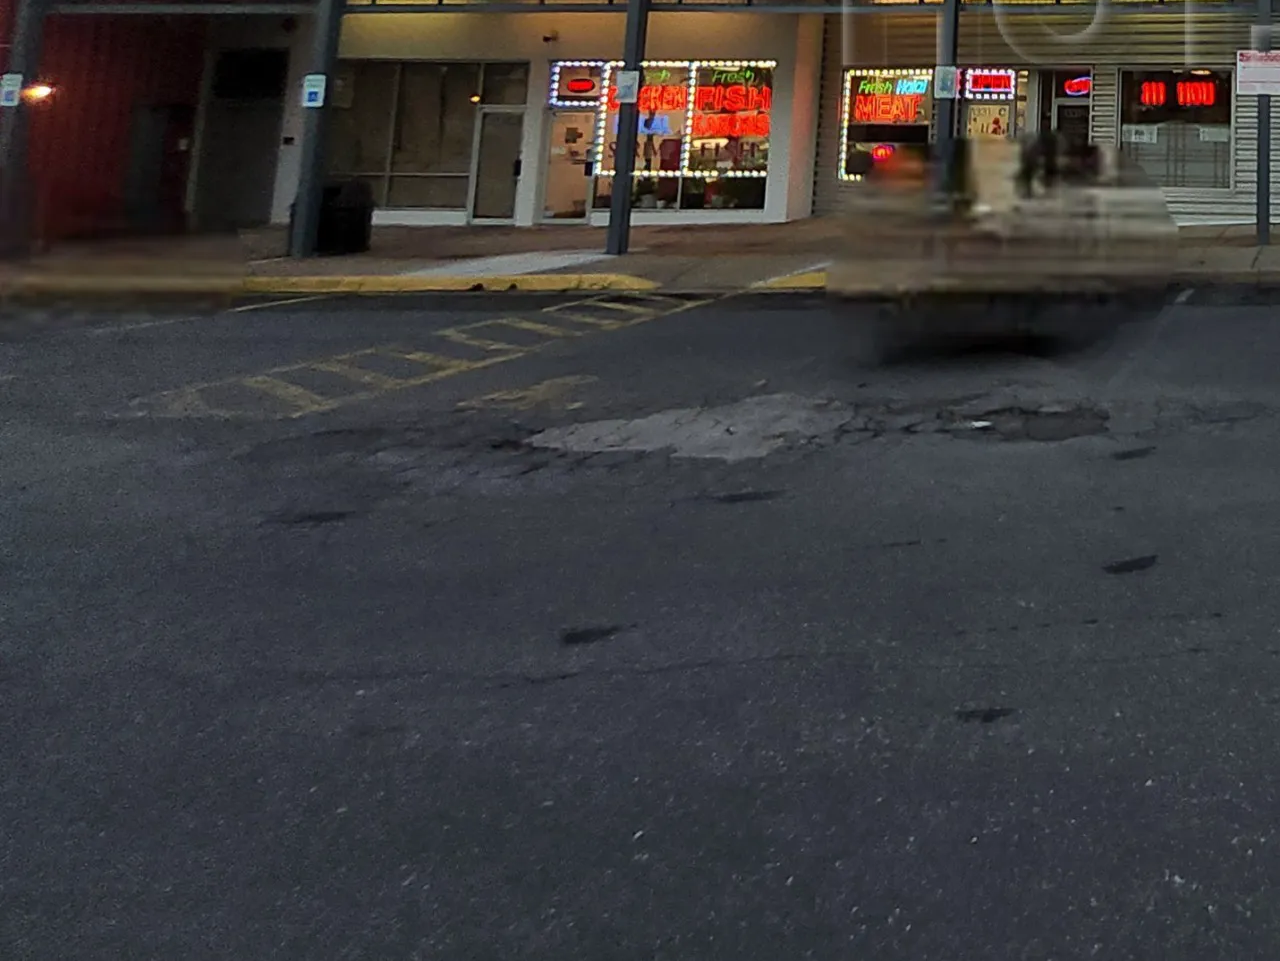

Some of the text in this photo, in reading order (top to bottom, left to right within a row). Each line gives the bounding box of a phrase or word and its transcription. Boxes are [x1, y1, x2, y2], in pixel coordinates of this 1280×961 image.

[695, 84, 772, 112] FISH
[858, 79, 893, 94] Fresh
[855, 95, 922, 123] MEAT
